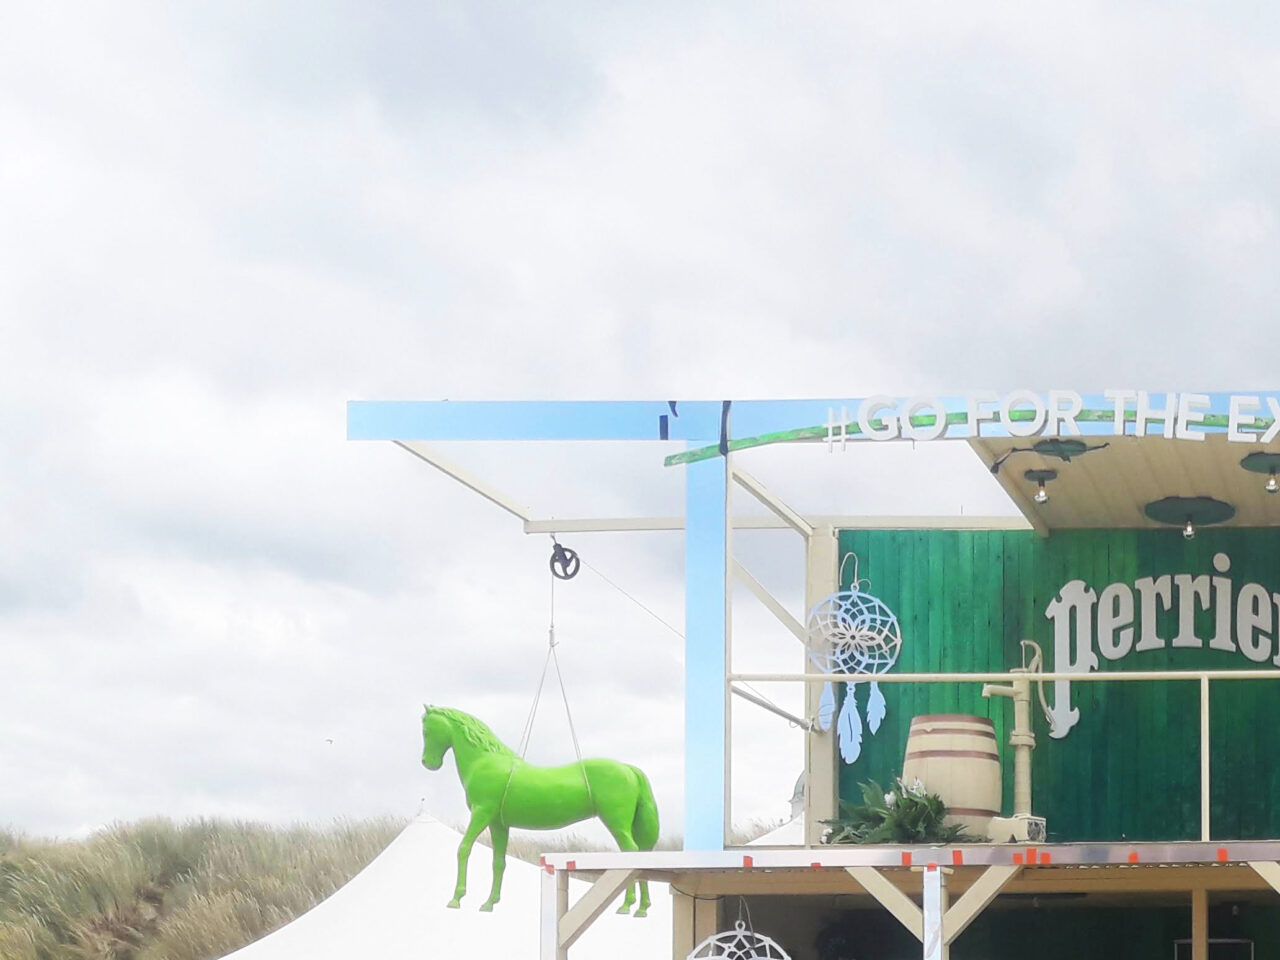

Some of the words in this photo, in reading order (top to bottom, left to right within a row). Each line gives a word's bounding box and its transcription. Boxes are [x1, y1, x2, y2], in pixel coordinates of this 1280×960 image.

[822, 393, 948, 453] #GO
[967, 389, 1084, 438] FOR
[1103, 389, 1211, 442] THE
